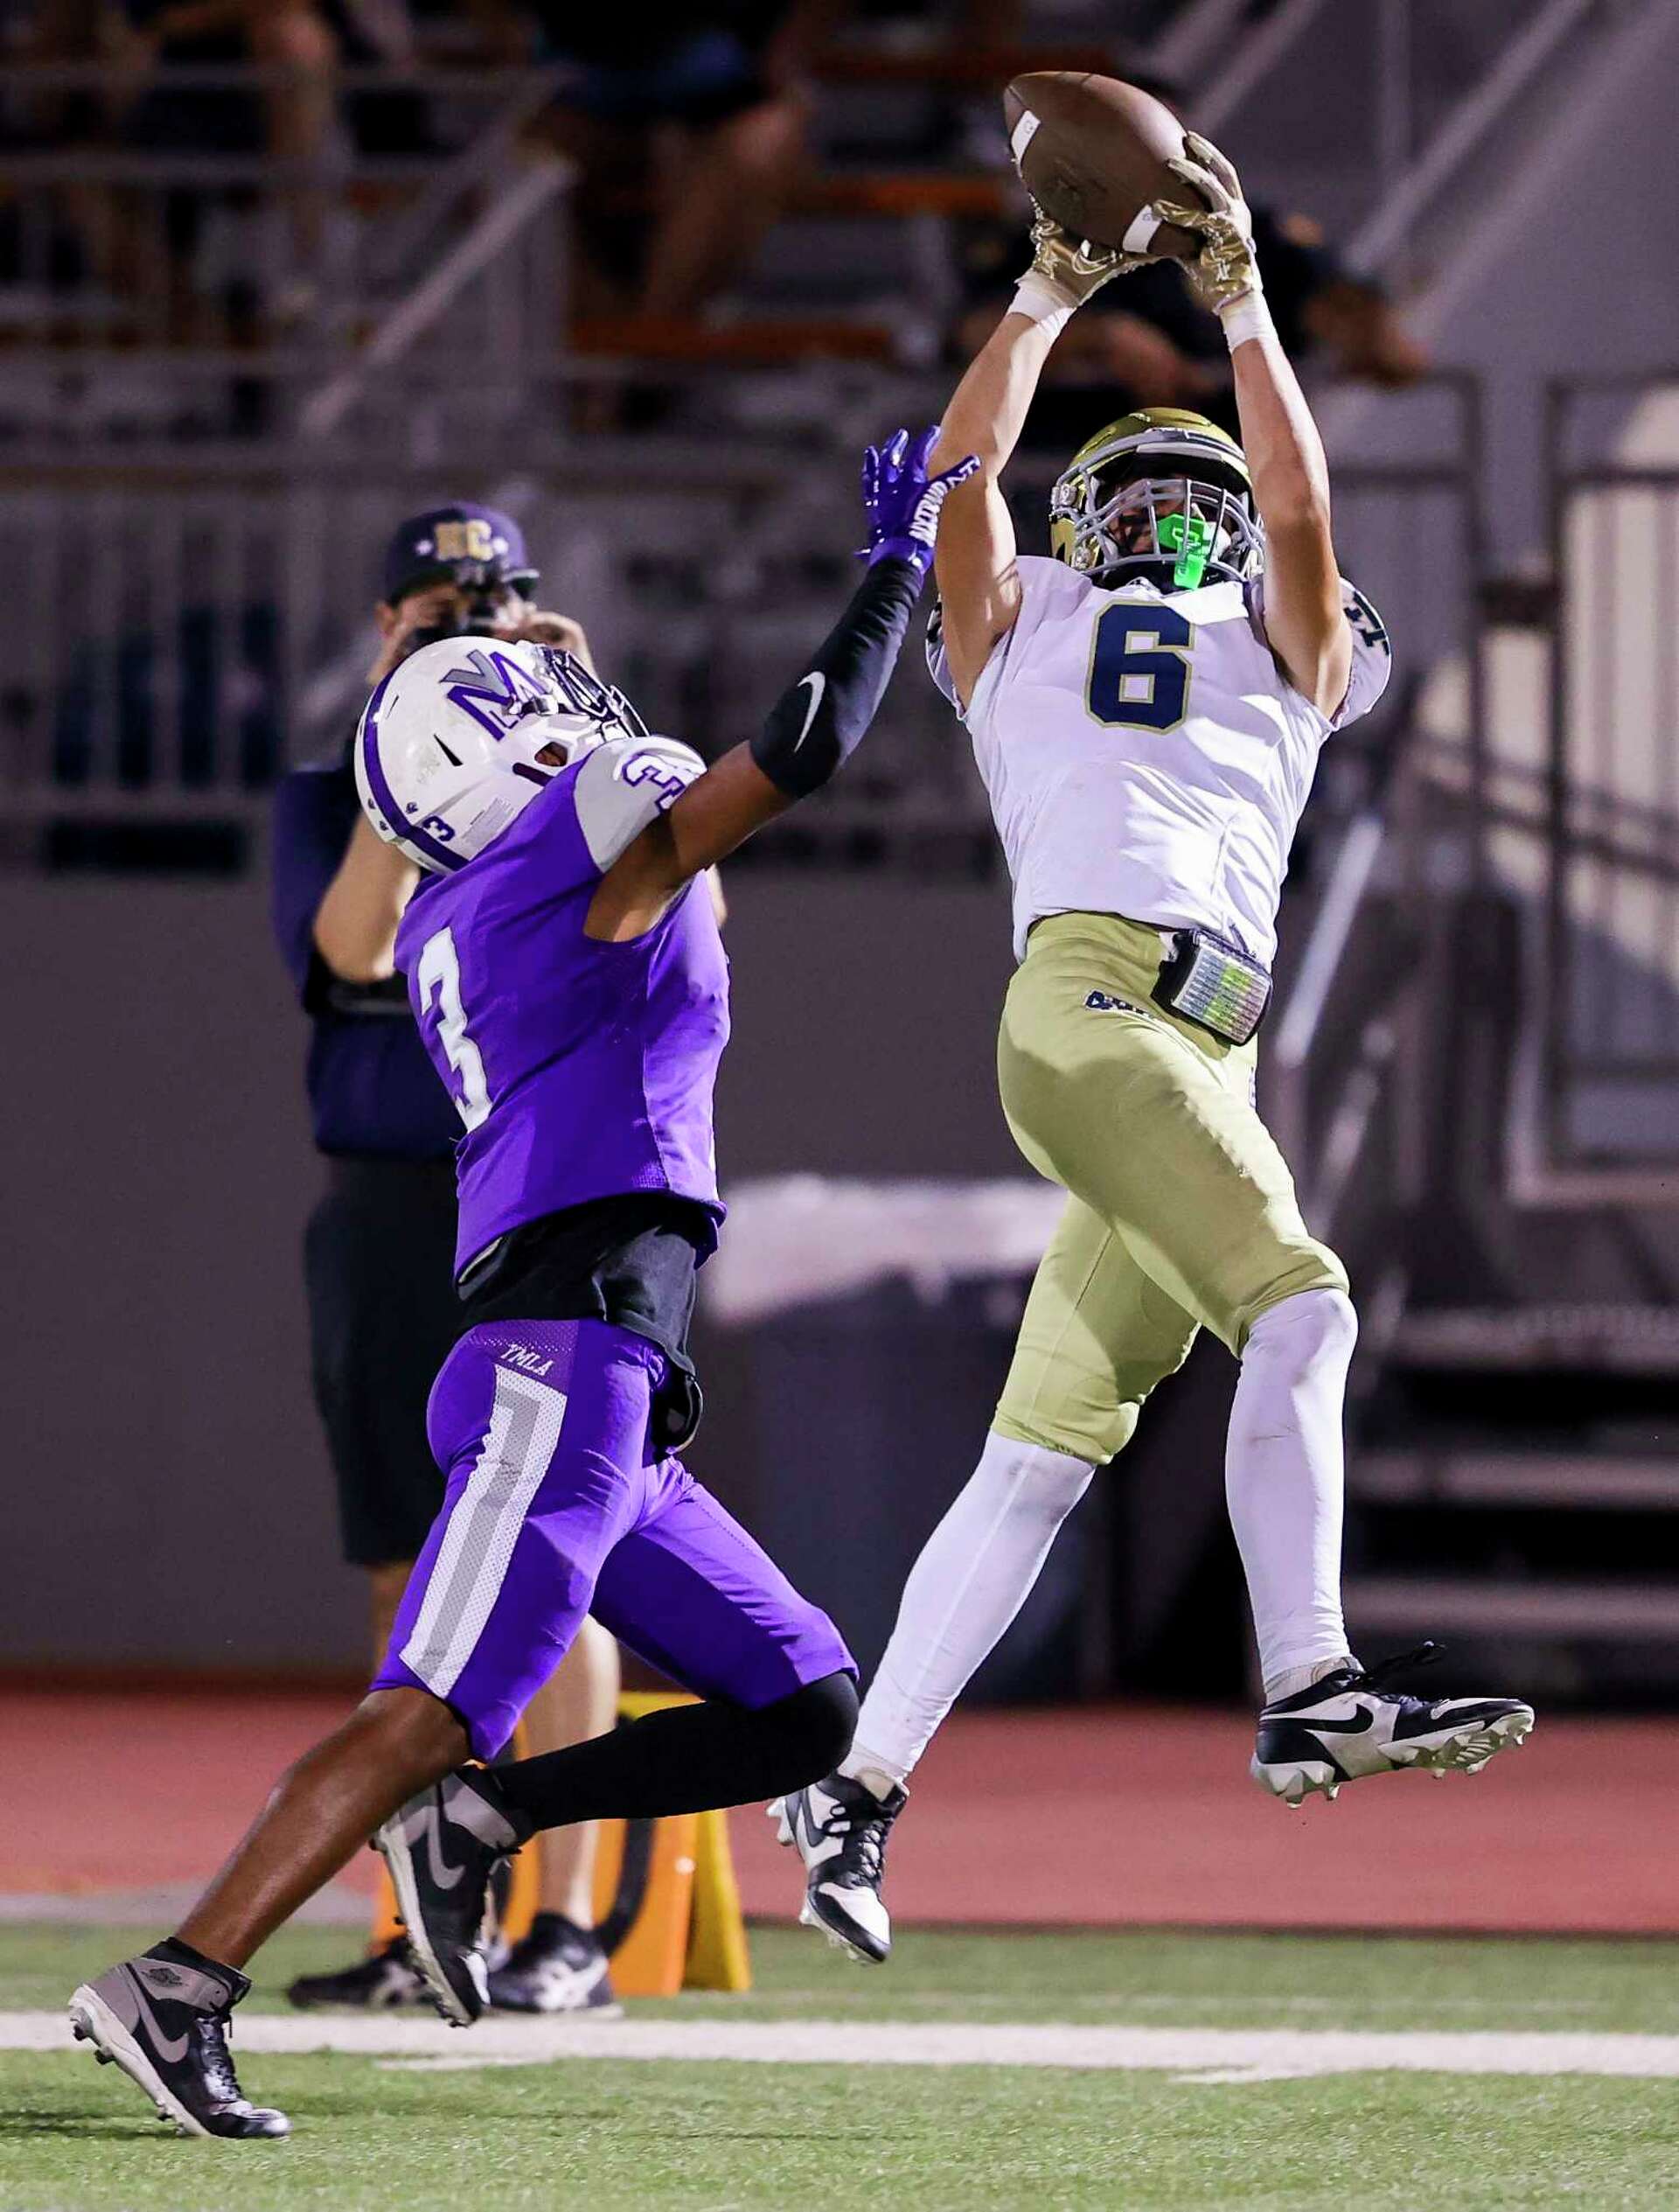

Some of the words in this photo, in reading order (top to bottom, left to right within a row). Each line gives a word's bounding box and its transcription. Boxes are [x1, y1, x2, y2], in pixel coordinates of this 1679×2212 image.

[1084, 598, 1196, 735] 6
[422, 815, 456, 842] 3
[622, 750, 697, 813] 3
[418, 926, 492, 1134] 3
